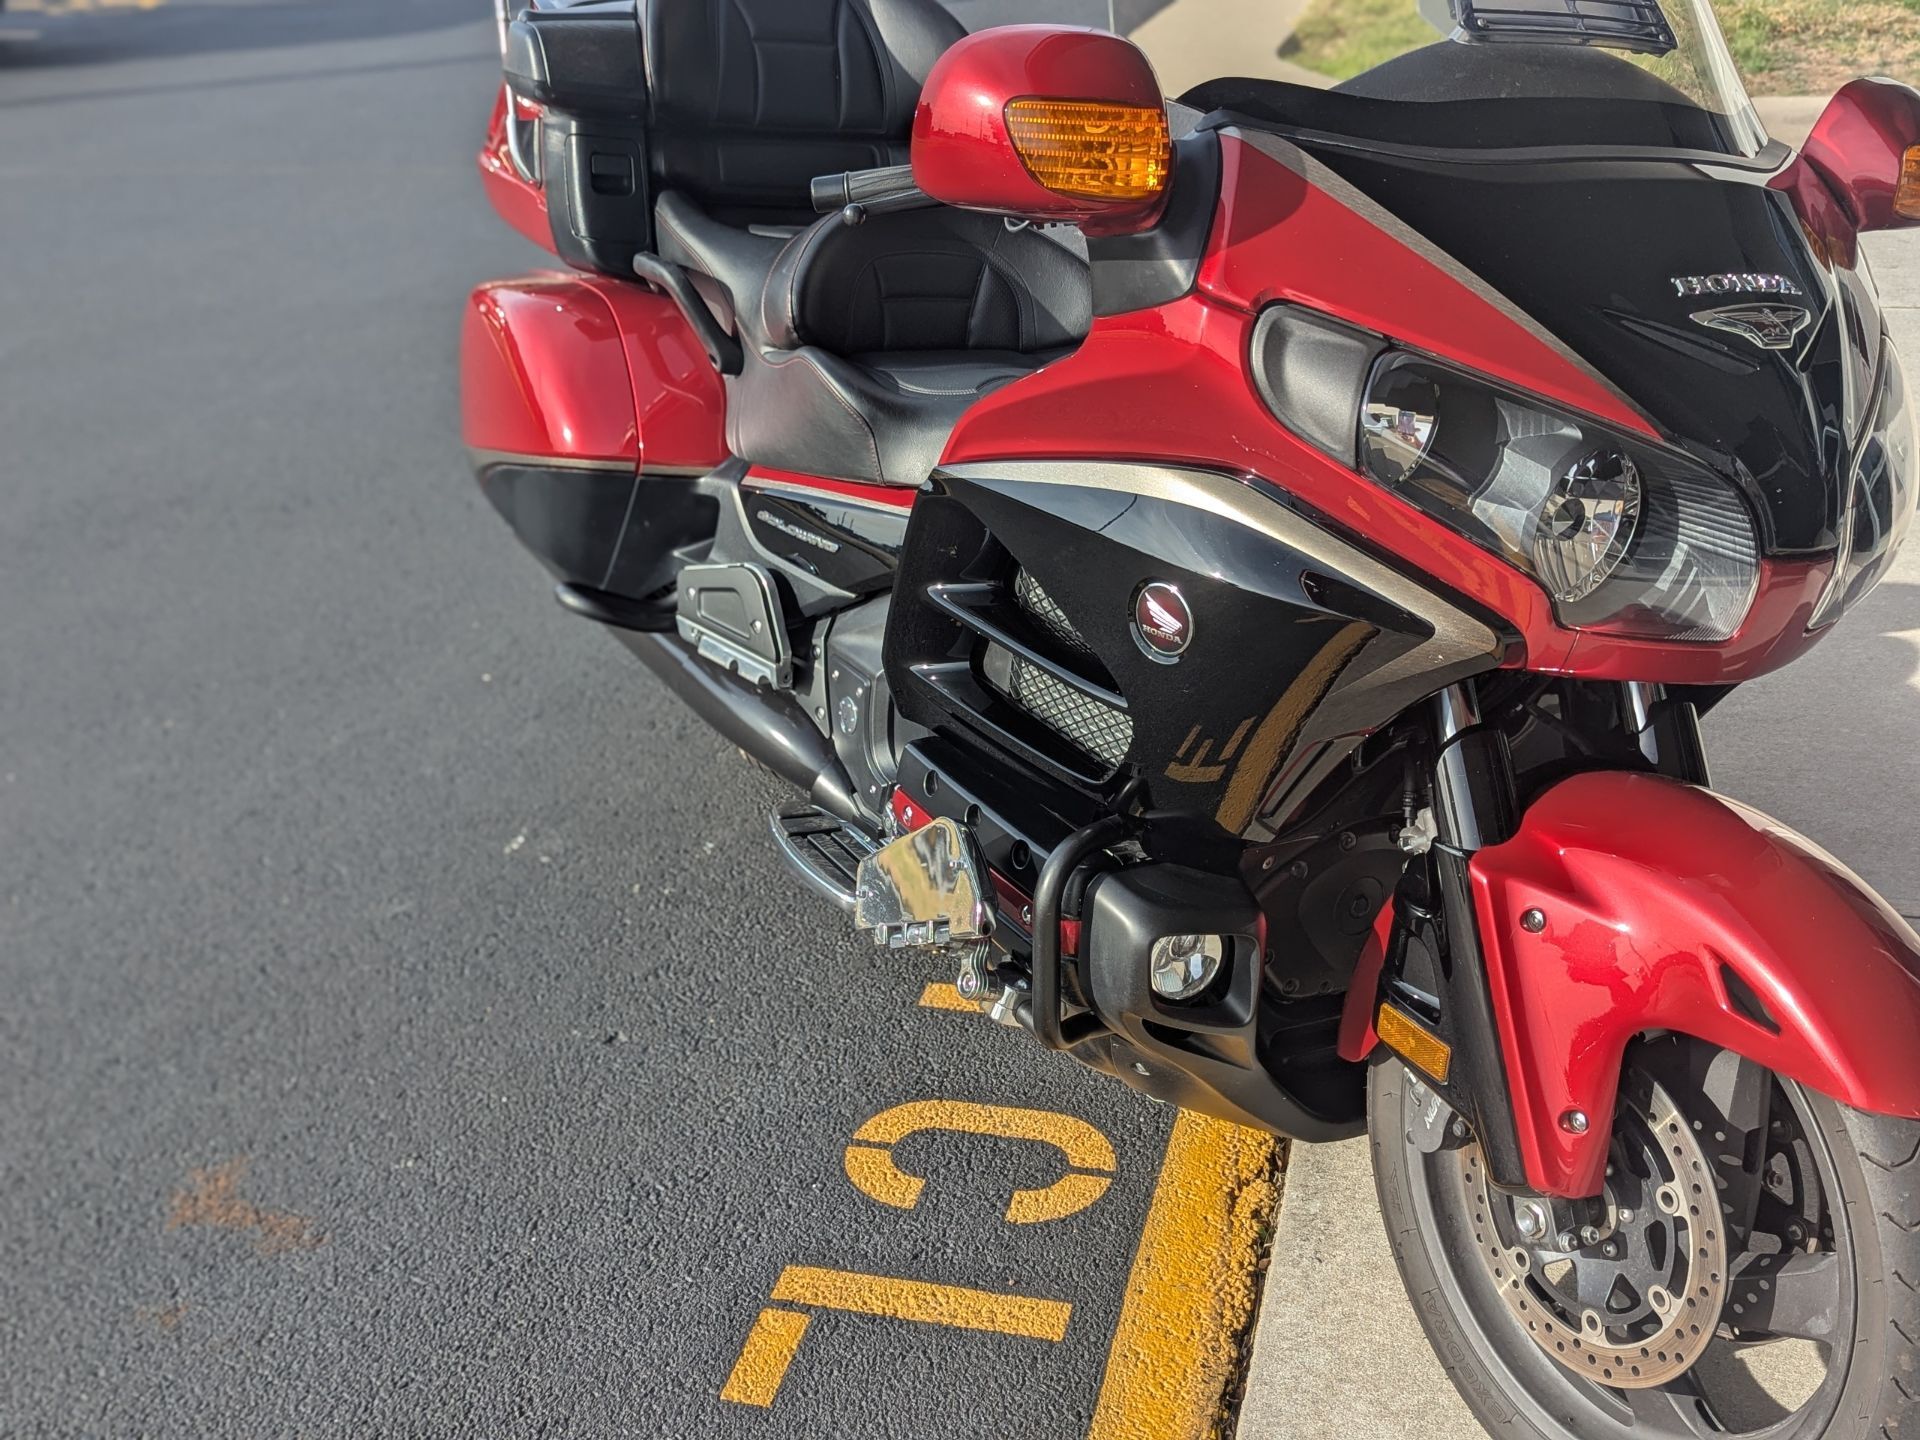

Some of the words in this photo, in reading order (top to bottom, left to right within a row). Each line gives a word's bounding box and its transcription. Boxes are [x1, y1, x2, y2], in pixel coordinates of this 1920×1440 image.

[1671, 274, 1802, 297] HONDA
[1142, 624, 1183, 645] HONDA
[720, 982, 1117, 1407] CL
[1425, 1296, 1507, 1424] EXEDRA
